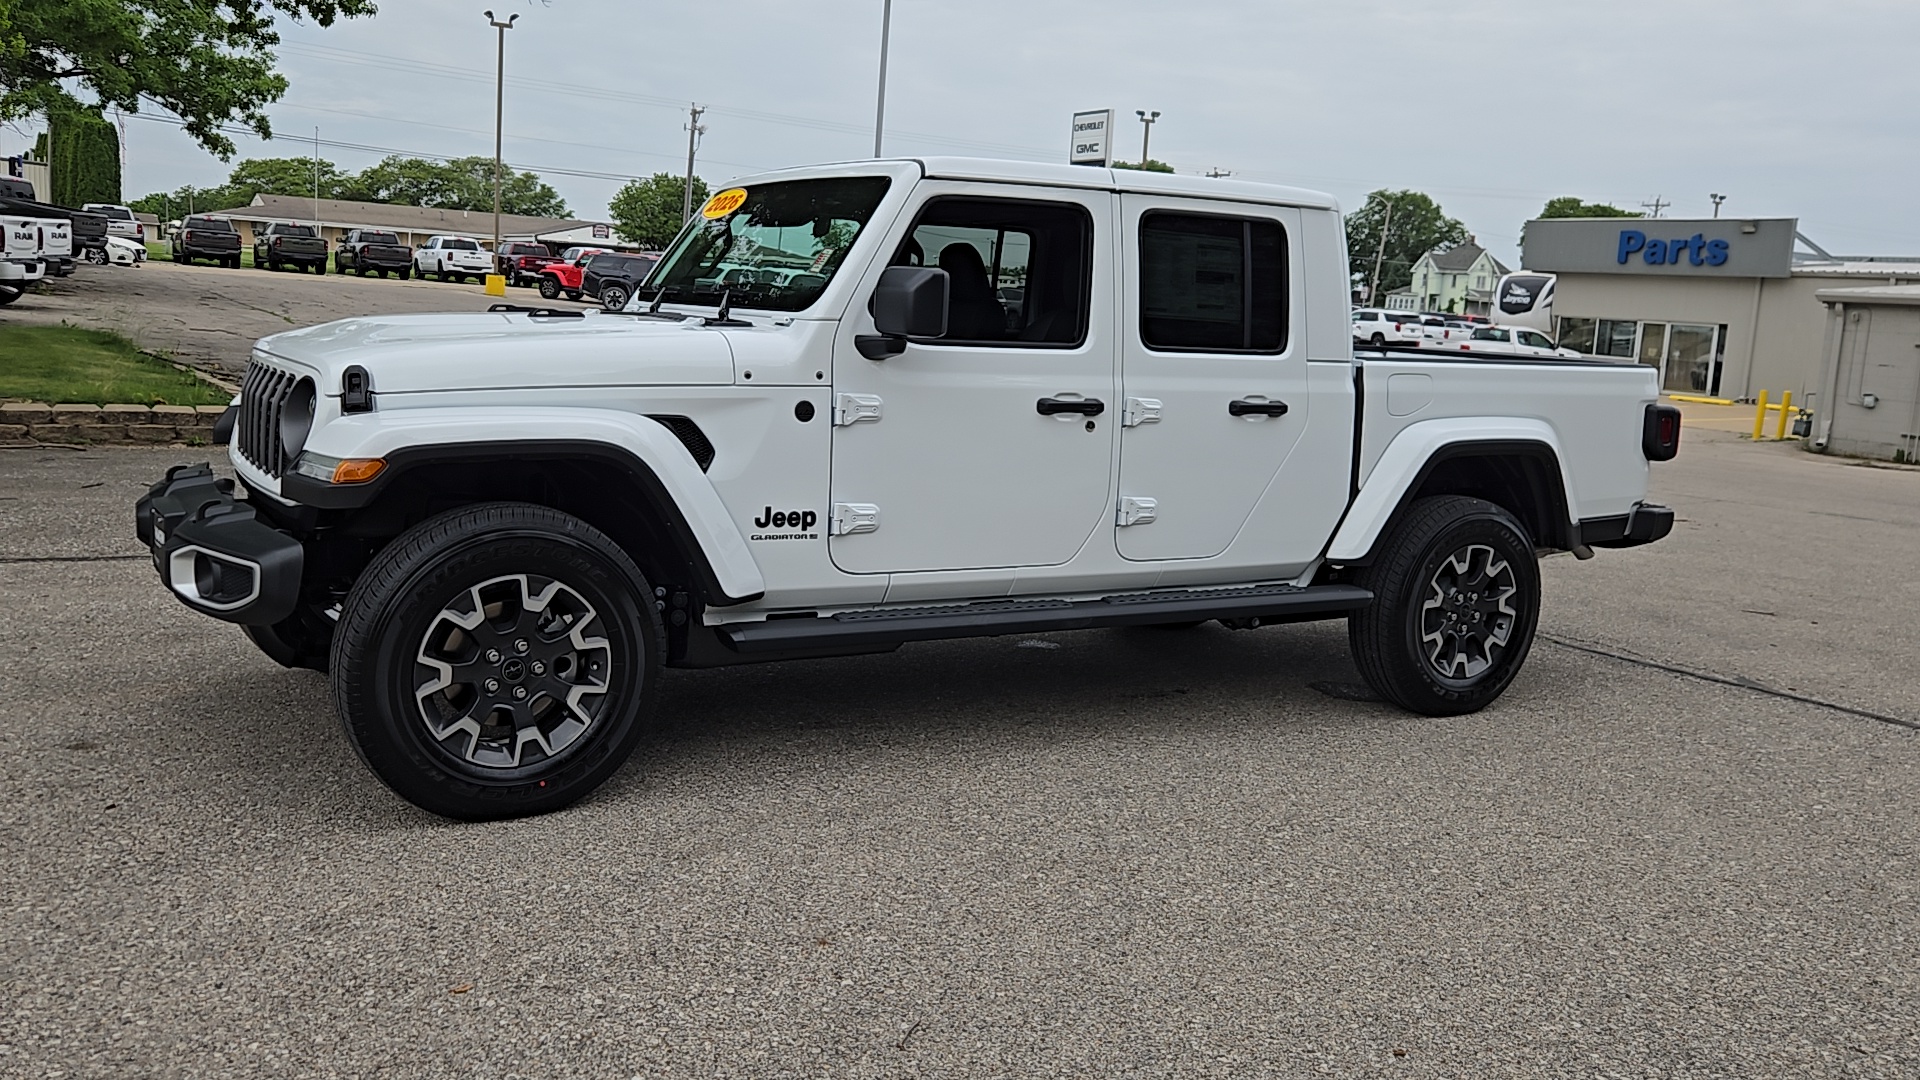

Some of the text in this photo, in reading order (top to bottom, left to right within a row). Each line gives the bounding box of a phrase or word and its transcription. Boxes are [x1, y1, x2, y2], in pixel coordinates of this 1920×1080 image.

[1076, 143, 1099, 154] GMC
[705, 194, 743, 212] 2026
[14, 232, 33, 240] RAM
[1617, 230, 1729, 266] Parts
[754, 506, 817, 531] Jeep
